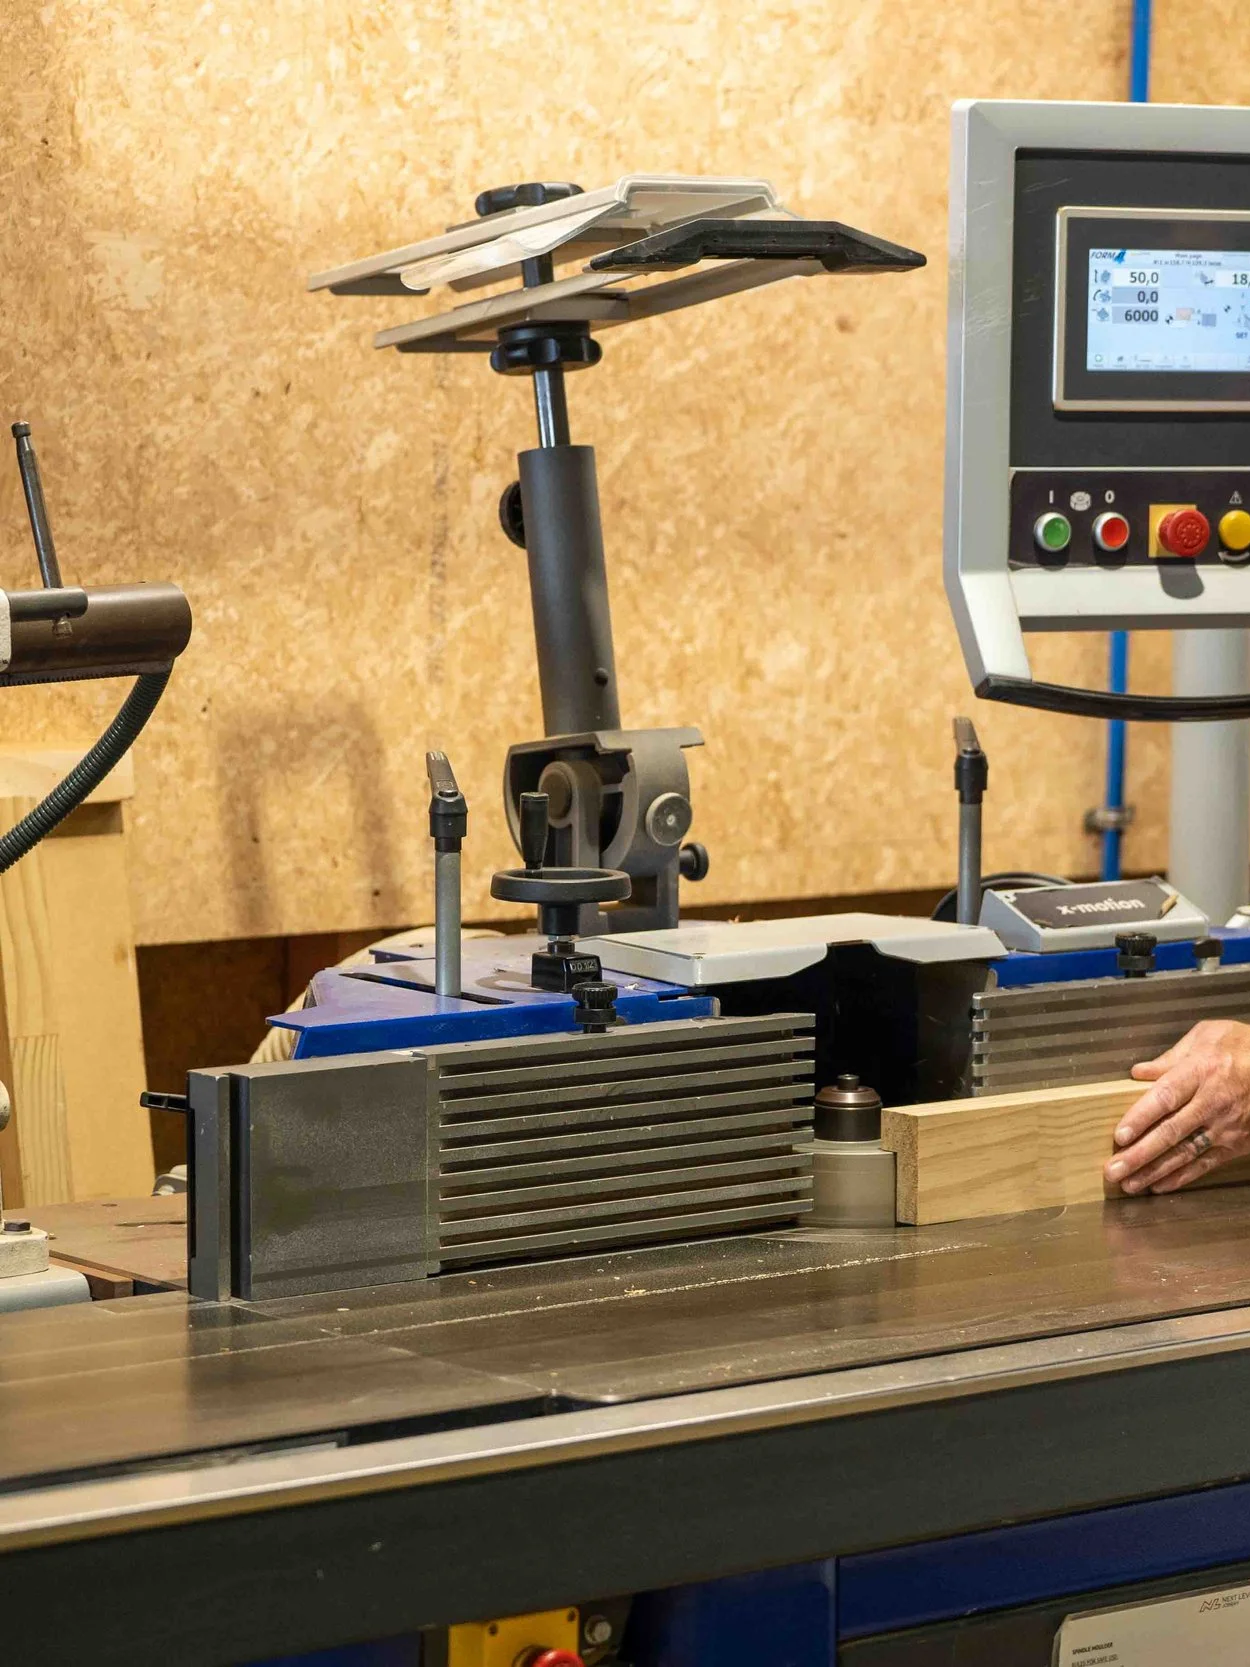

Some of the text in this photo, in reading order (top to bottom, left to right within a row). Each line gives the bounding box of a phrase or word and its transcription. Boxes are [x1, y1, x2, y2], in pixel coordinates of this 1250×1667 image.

[1129, 271, 1159, 286] 50,0
[1137, 290, 1159, 305] 0,0
[1124, 309, 1159, 323] 6000
